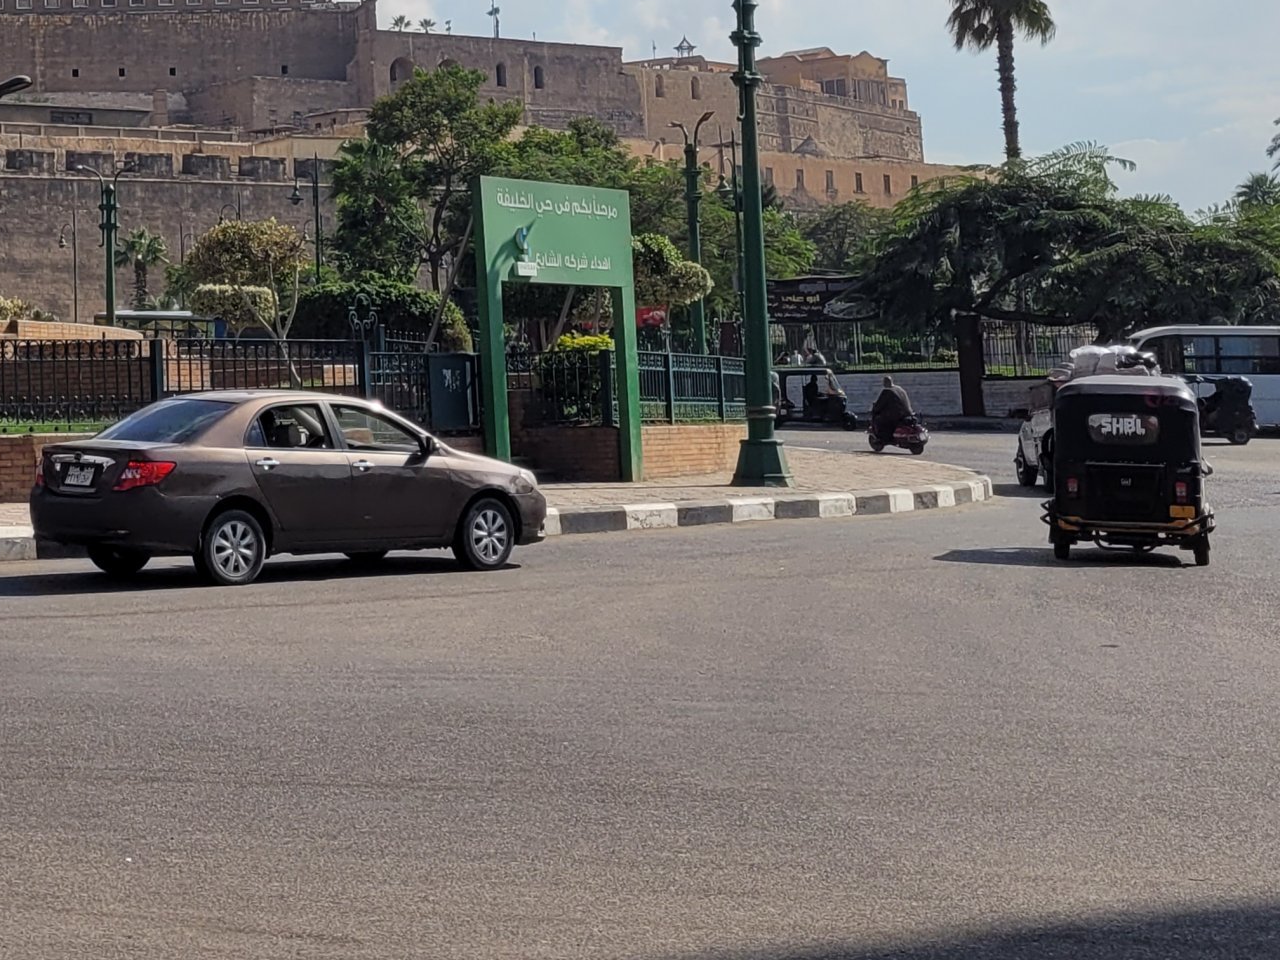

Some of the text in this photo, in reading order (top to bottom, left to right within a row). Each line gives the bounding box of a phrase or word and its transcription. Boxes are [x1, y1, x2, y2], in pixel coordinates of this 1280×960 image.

[497, 188, 534, 212] الخليفة
[535, 199, 553, 218] حي
[571, 198, 592, 219] بكم
[1101, 417, 1146, 436] SHBL
